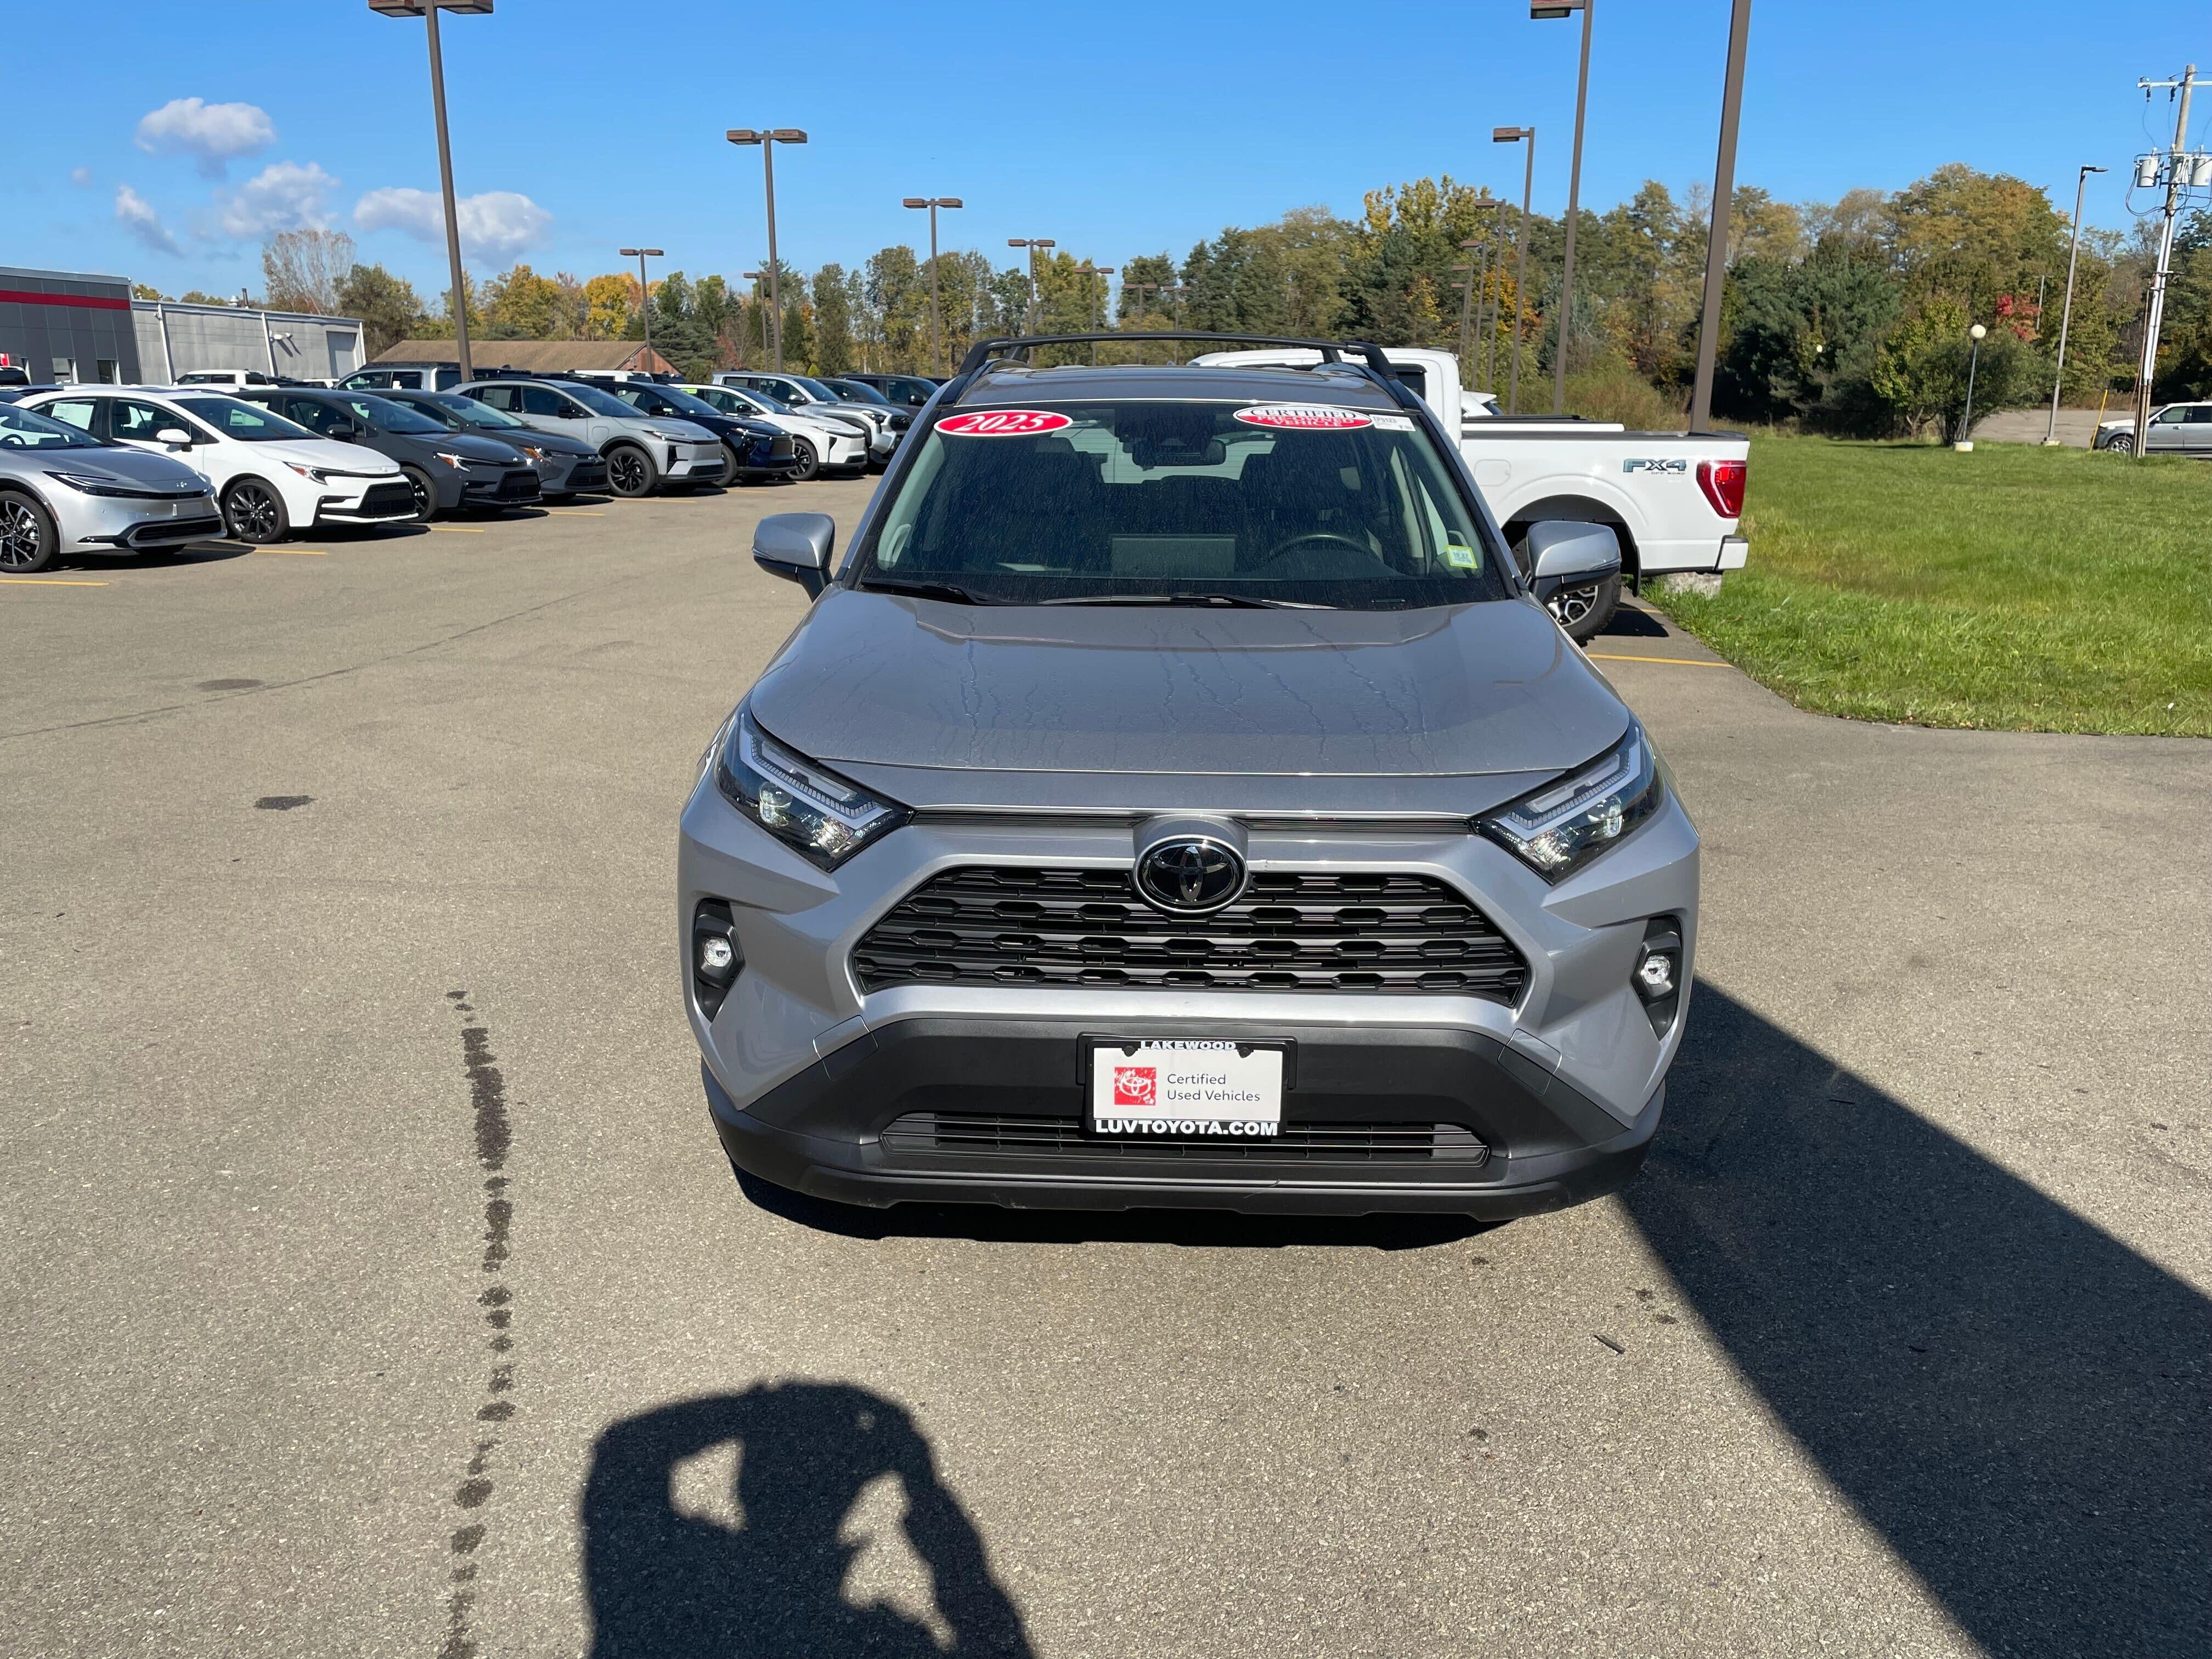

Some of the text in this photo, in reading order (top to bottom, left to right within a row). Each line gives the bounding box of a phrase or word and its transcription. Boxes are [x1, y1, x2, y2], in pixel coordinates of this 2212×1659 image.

[1250, 409, 1356, 419] CERTIFIED
[952, 414, 1054, 432] 2025
[1273, 419, 1342, 427] VEHICLE
[1623, 459, 1687, 473] FX4
[1140, 1040, 1236, 1051] LAKEWOOD
[1167, 1073, 1226, 1085] Certified
[1167, 1090, 1261, 1102] Used Vehicles
[1096, 1120, 1278, 1136] LUVTOYOTA.COM
